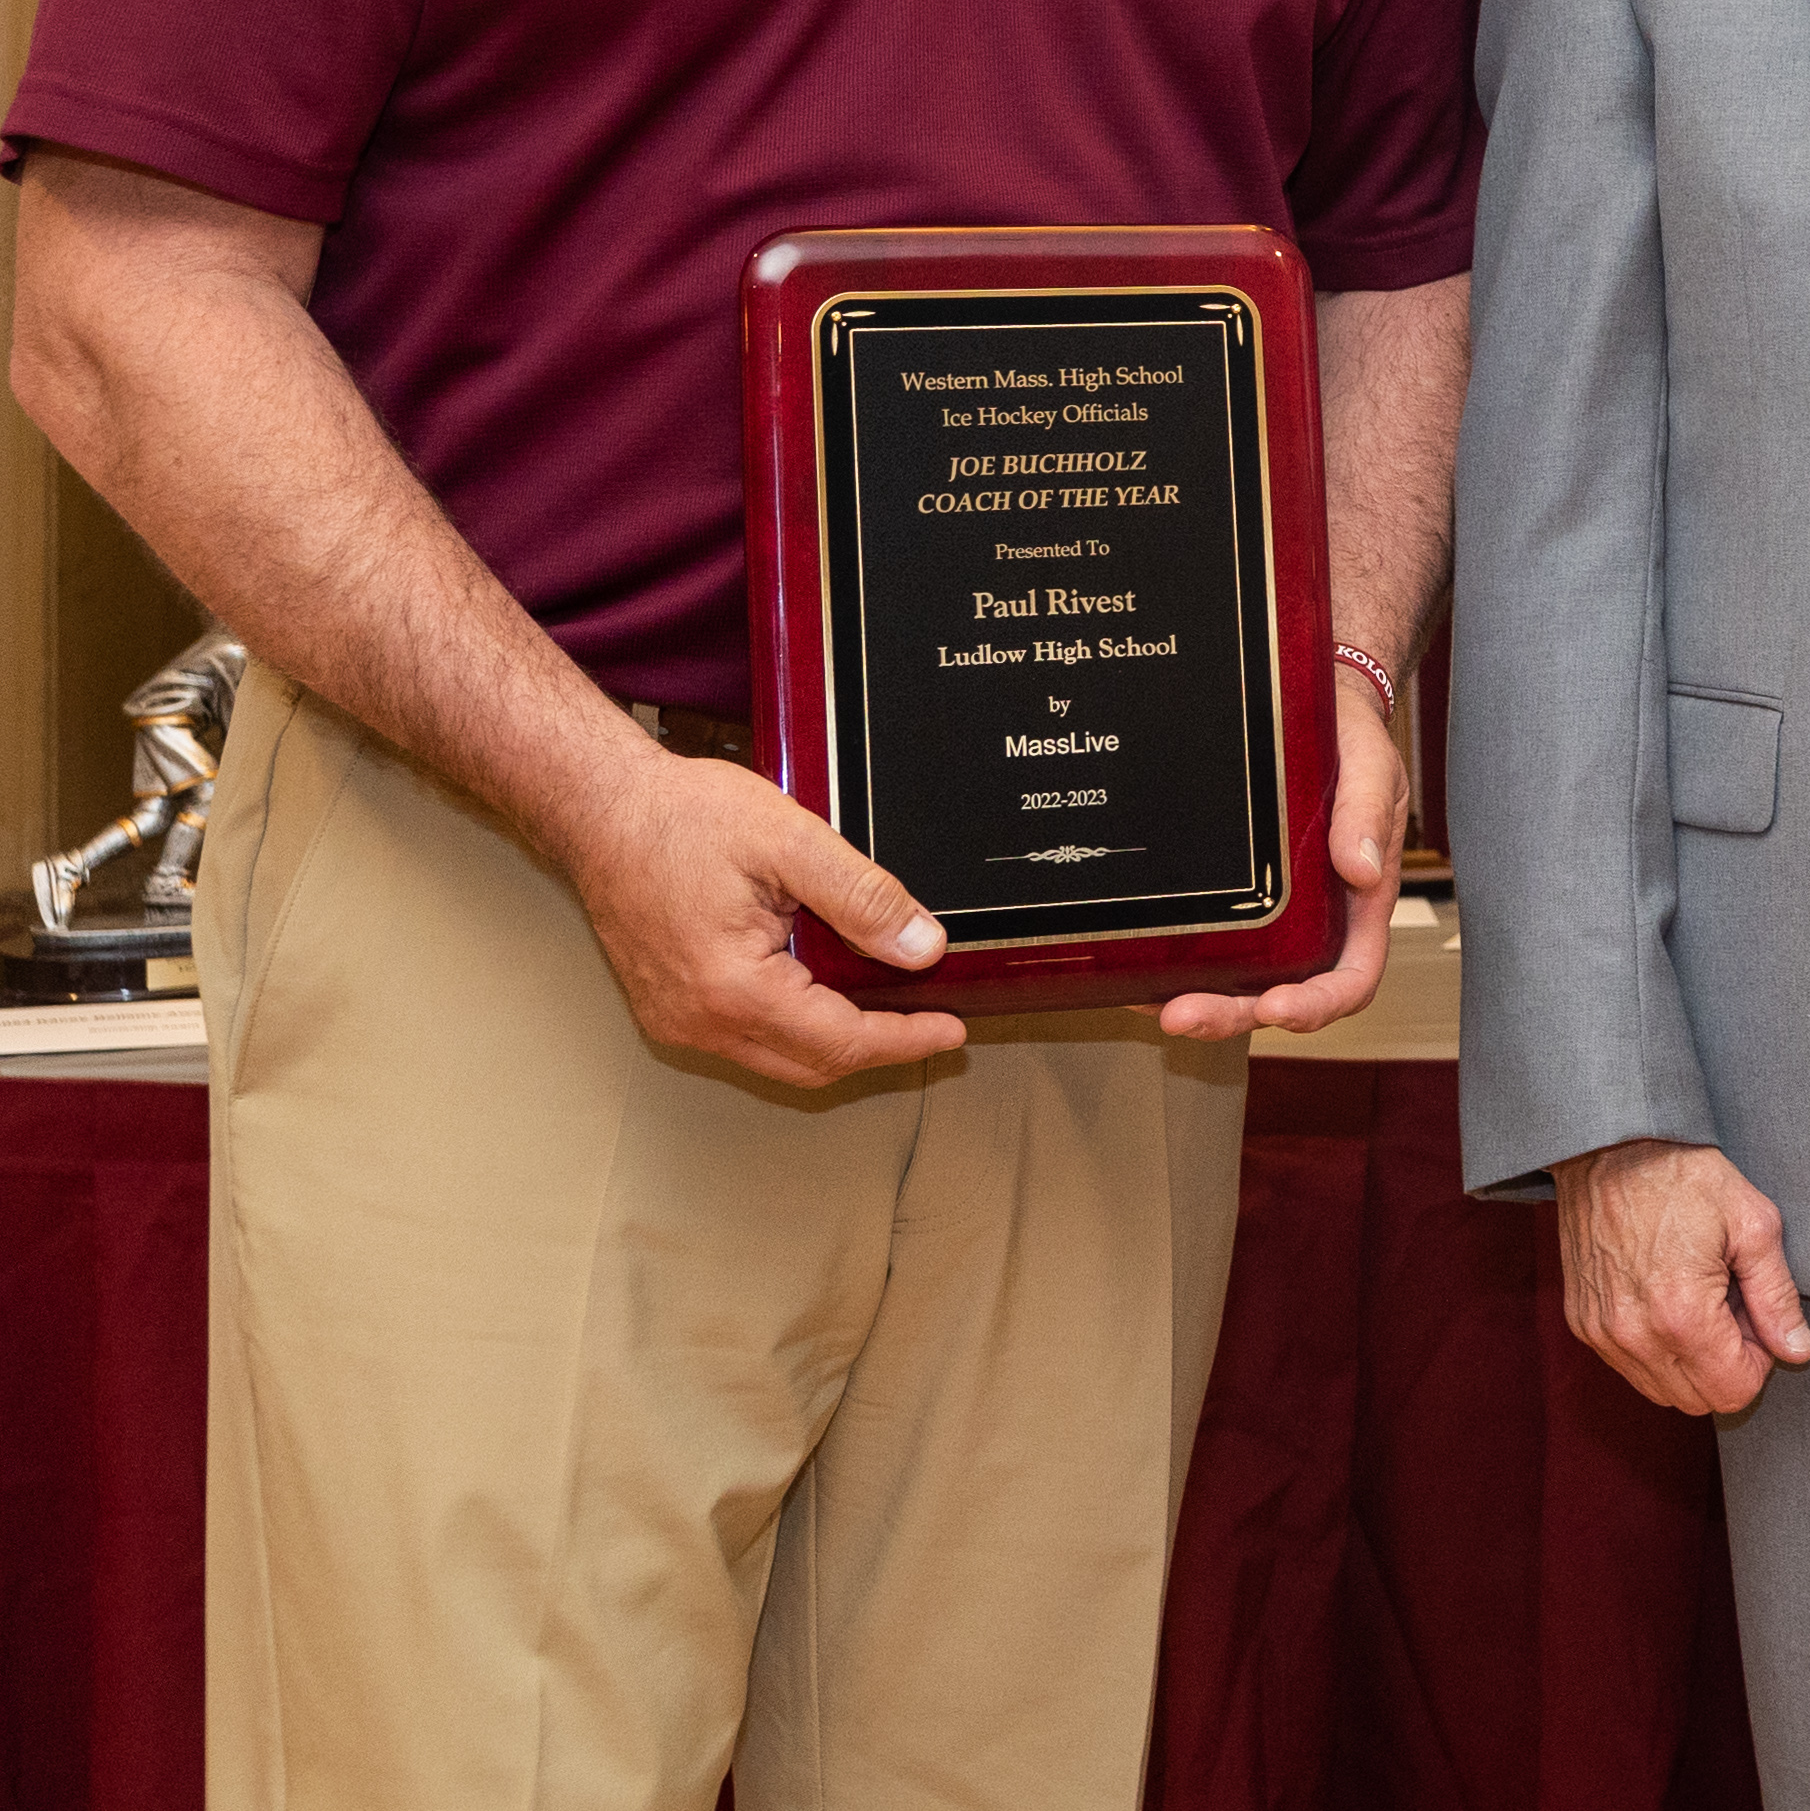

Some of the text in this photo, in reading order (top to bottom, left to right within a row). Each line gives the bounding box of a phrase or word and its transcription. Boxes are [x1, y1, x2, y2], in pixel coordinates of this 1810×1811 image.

[901, 364, 1184, 392] Western Mass. High School
[942, 402, 1149, 430] Ice Hockey Officials
[948, 450, 1147, 482] JOE BUCHHOLZ
[917, 484, 1180, 514] COACH OF THE YEAR
[995, 539, 1111, 560] Presented To
[972, 588, 1136, 620] Paul Rivest
[937, 633, 1178, 667] Ludlow High School
[1048, 695, 1072, 718] by
[1005, 731, 1120, 758] MassLive
[1020, 788, 1108, 810] 2022-2023
